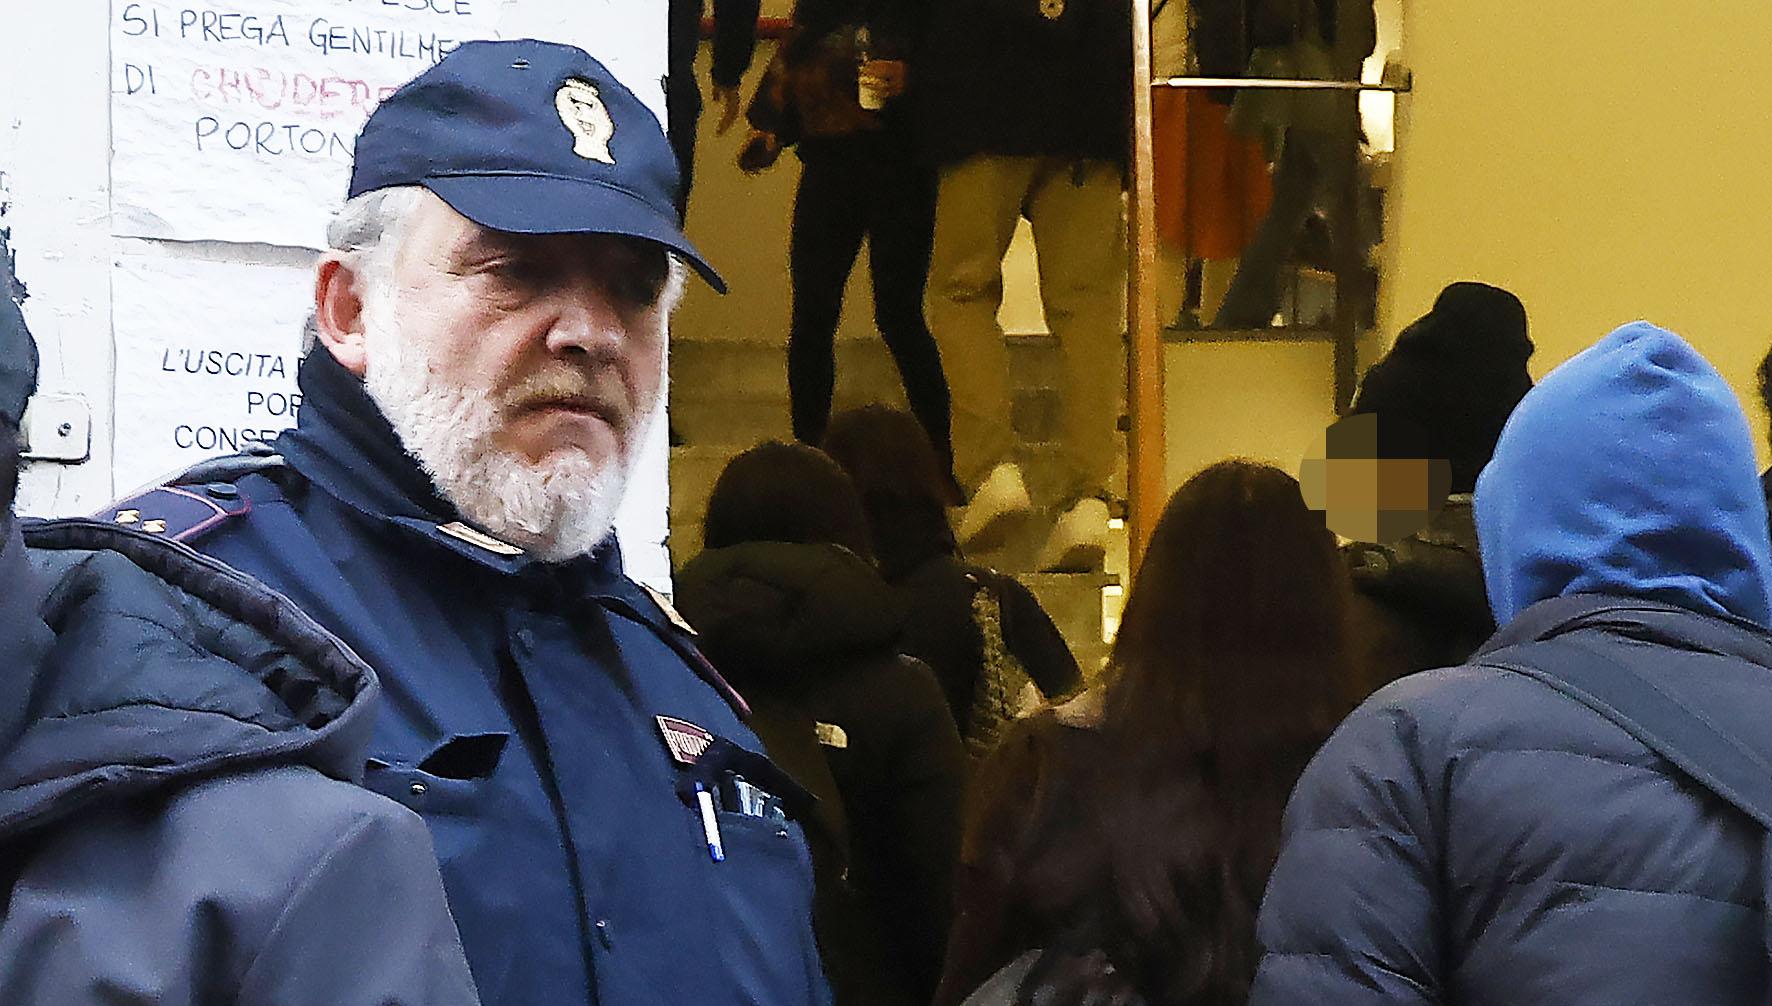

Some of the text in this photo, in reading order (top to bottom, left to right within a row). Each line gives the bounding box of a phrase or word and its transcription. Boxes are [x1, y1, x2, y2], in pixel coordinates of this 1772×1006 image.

[122, 4, 159, 37] SI
[180, 9, 290, 46] PREGA
[125, 63, 156, 95] DI
[162, 347, 286, 379] L'USCITA
